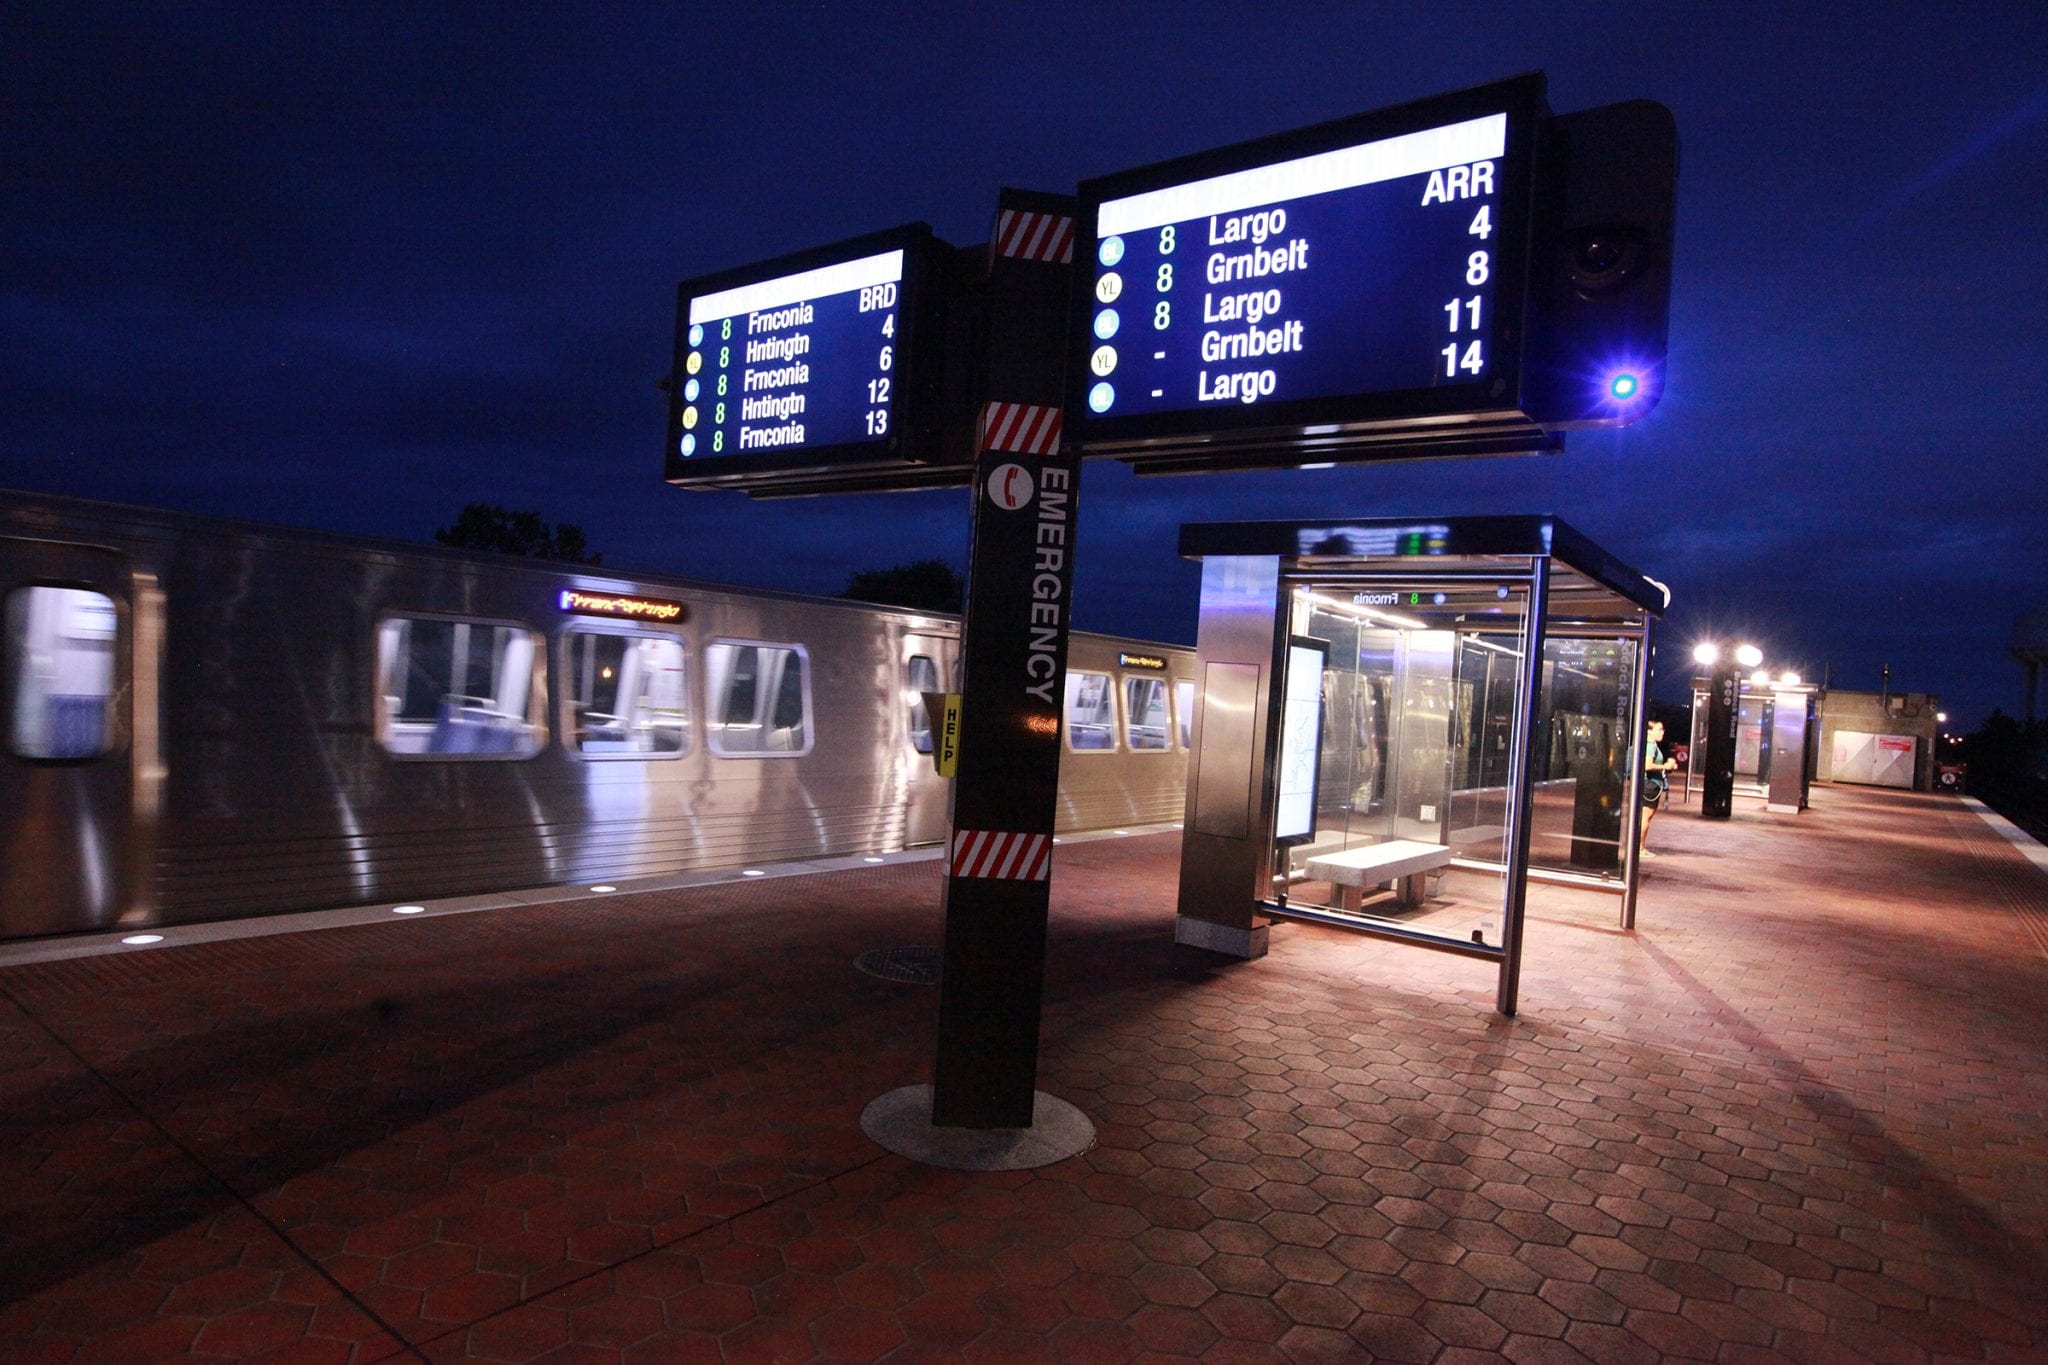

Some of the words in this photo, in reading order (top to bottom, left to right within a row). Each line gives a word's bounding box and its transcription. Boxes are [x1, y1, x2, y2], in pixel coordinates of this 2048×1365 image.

[1159, 225, 1175, 255] 8
[1209, 208, 1286, 246] Largo
[1421, 160, 1494, 206] ARR
[1101, 281, 1116, 296] YL
[1156, 263, 1173, 292] 8
[1206, 239, 1309, 284] Grnbelt
[1469, 205, 1492, 240] 4
[721, 318, 731, 340] 8
[748, 301, 813, 335] Frnconia
[859, 283, 896, 312] BRD
[1153, 301, 1170, 330] 8
[1203, 289, 1281, 324] Largo
[1465, 250, 1489, 285] 8
[719, 346, 729, 368] 8
[746, 333, 810, 364] Hntingtn
[882, 314, 894, 338] 4
[1097, 354, 1111, 368] YL
[1201, 320, 1304, 362] Grnbelt
[1444, 295, 1481, 332] 11
[715, 402, 725, 424] 8
[742, 391, 805, 420] Hntingtn
[868, 378, 890, 403] 12
[717, 374, 727, 396] 8
[744, 361, 809, 392] Frnconia
[880, 346, 892, 371] 6
[1198, 369, 1276, 404] Largo
[1441, 340, 1483, 377] 14
[713, 430, 723, 452] 8
[740, 420, 805, 449] Frnconia
[865, 409, 887, 435] 13
[1026, 467, 1069, 704] EMERGENCY
[944, 709, 957, 762] HELP
